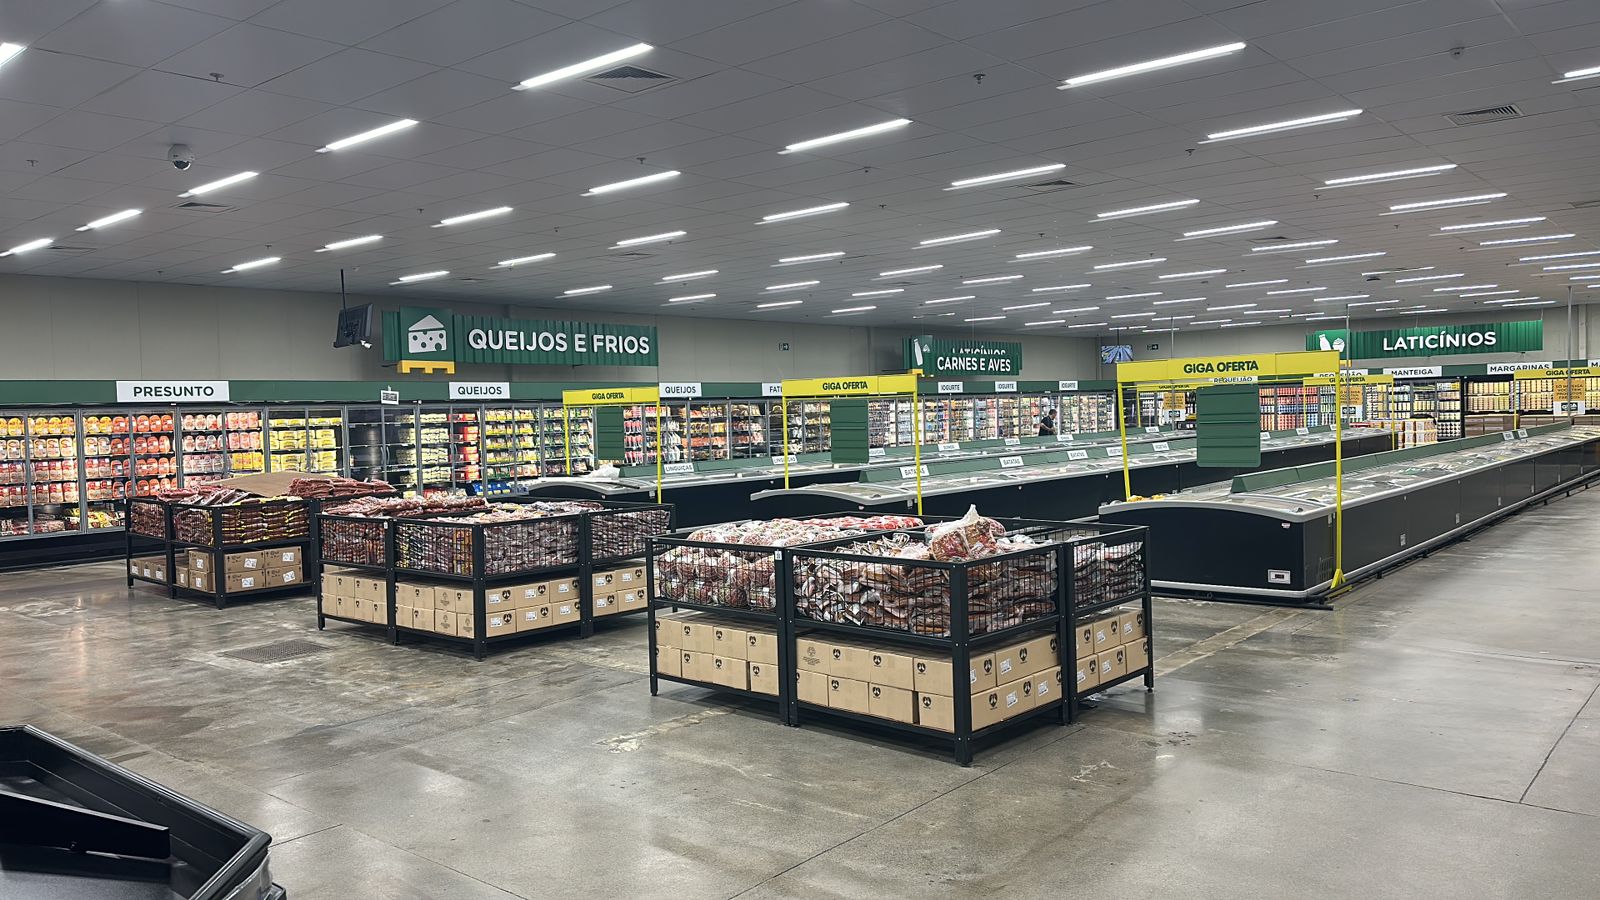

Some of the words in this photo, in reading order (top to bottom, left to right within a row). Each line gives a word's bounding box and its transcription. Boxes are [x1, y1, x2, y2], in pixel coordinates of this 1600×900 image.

[468, 328, 568, 352] QUEIJOS
[574, 333, 587, 353] E
[593, 334, 650, 354] FRIOS
[1383, 330, 1497, 351] LATICÍNIOS
[937, 356, 978, 371] CARNES
[979, 357, 986, 371] E
[988, 358, 1011, 372] AVES
[1183, 363, 1214, 374] GIGA
[1216, 360, 1259, 372] OFERTA
[1490, 363, 1550, 372] MARGARINAS
[1391, 368, 1433, 376] MANTEIGA
[457, 386, 503, 395] QUEIJOS
[664, 386, 697, 395] QUEIJOS
[822, 382, 841, 391] GIGA
[842, 381, 868, 390] OFERTA
[940, 384, 961, 392] IOGURTE
[997, 382, 1015, 390] IOGURTE
[133, 386, 214, 397] PRESUNTO
[592, 392, 606, 400] GIGA
[606, 392, 625, 400] OFERTA
